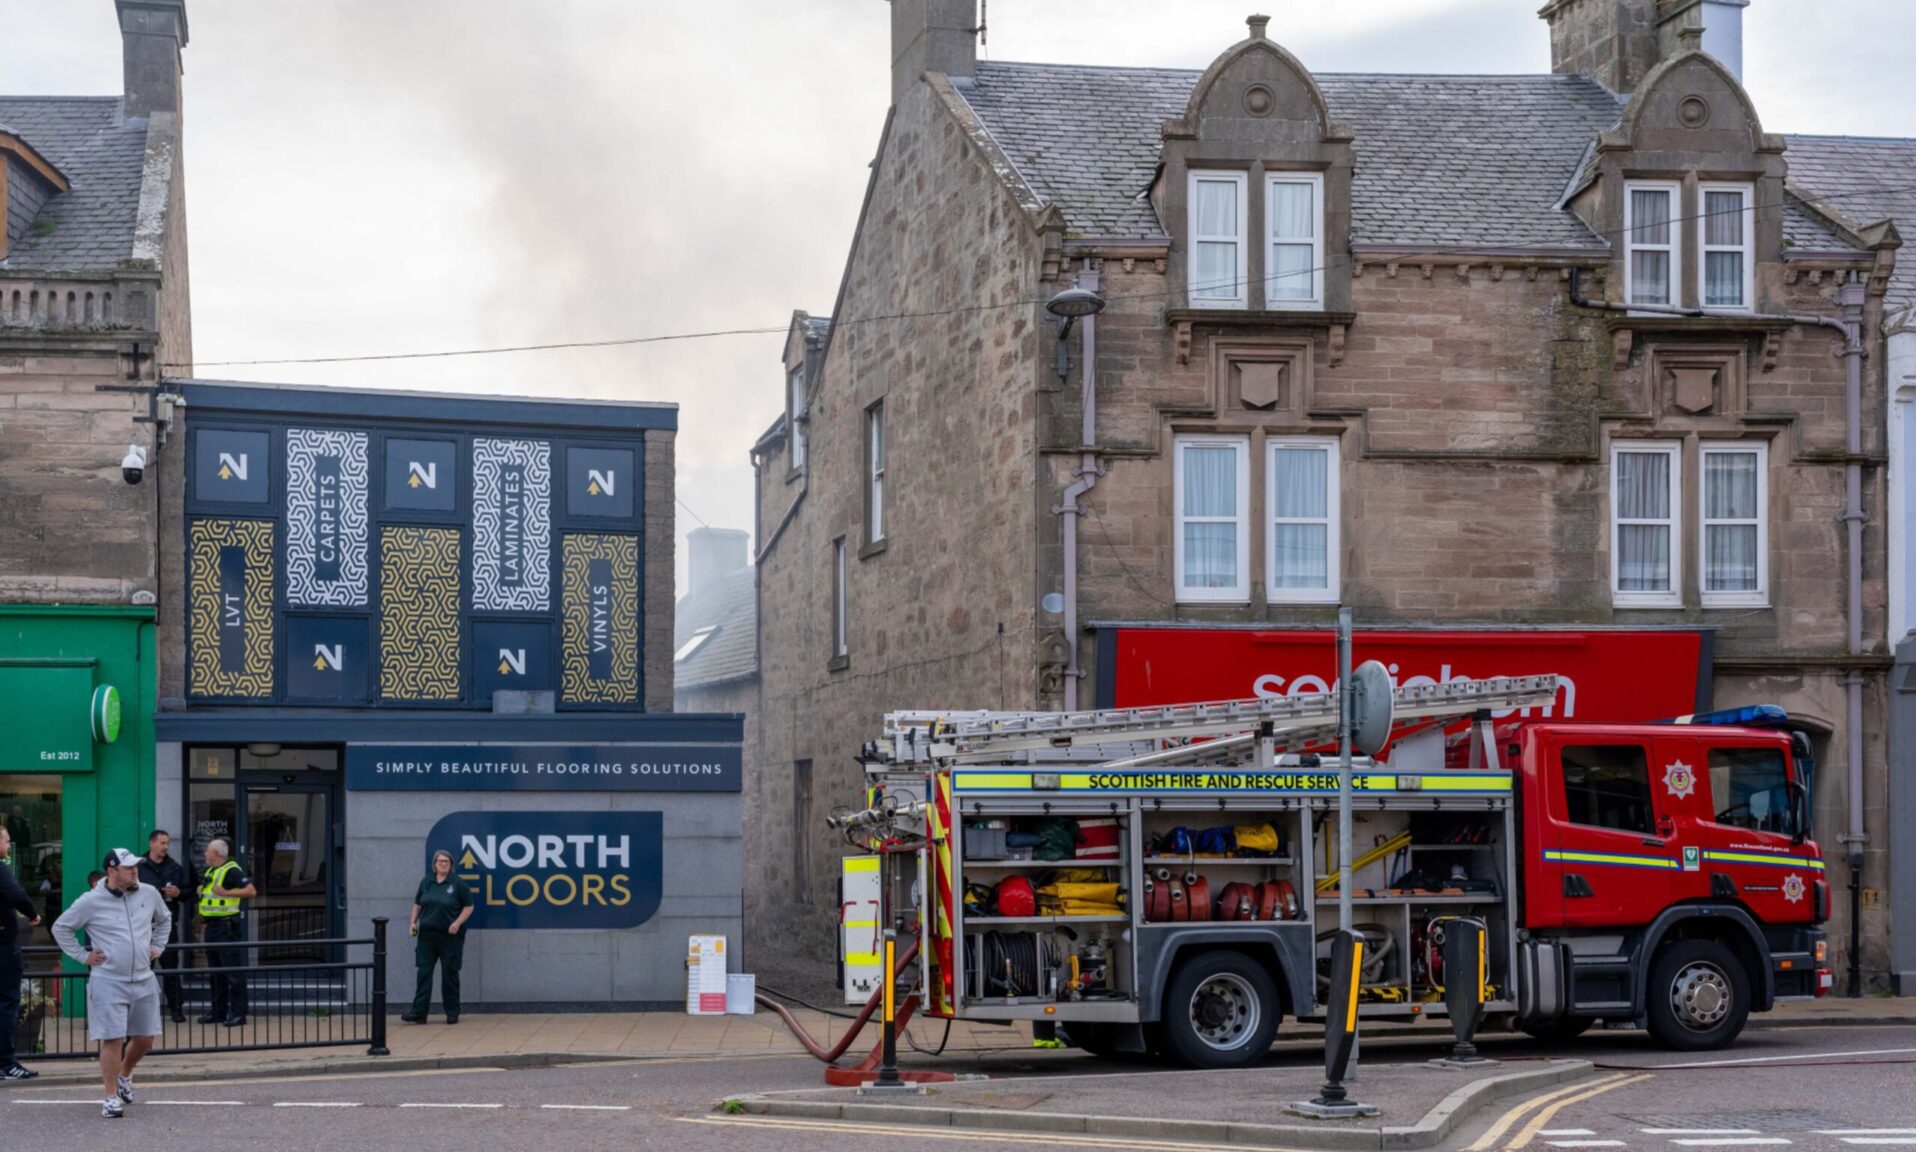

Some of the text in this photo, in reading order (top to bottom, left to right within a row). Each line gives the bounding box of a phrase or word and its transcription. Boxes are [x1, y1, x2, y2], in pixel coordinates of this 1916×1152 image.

[219, 452, 248, 481] N
[409, 461, 436, 489] N
[588, 469, 615, 497] N
[320, 474, 336, 563] CARPETS
[504, 470, 520, 581] LAMINATES
[225, 593, 241, 627] LVT
[593, 585, 608, 653] VINYLS
[314, 644, 343, 672] N
[499, 648, 526, 675] N
[40, 750, 80, 761] Est 2012
[375, 761, 723, 776] SIMPLY BEAUTIFUL FLOORING SOLUTIONS
[1089, 774, 1369, 790] SCOTTISH FIRE AND RESCUE SERVCE
[461, 834, 630, 870] NORTH
